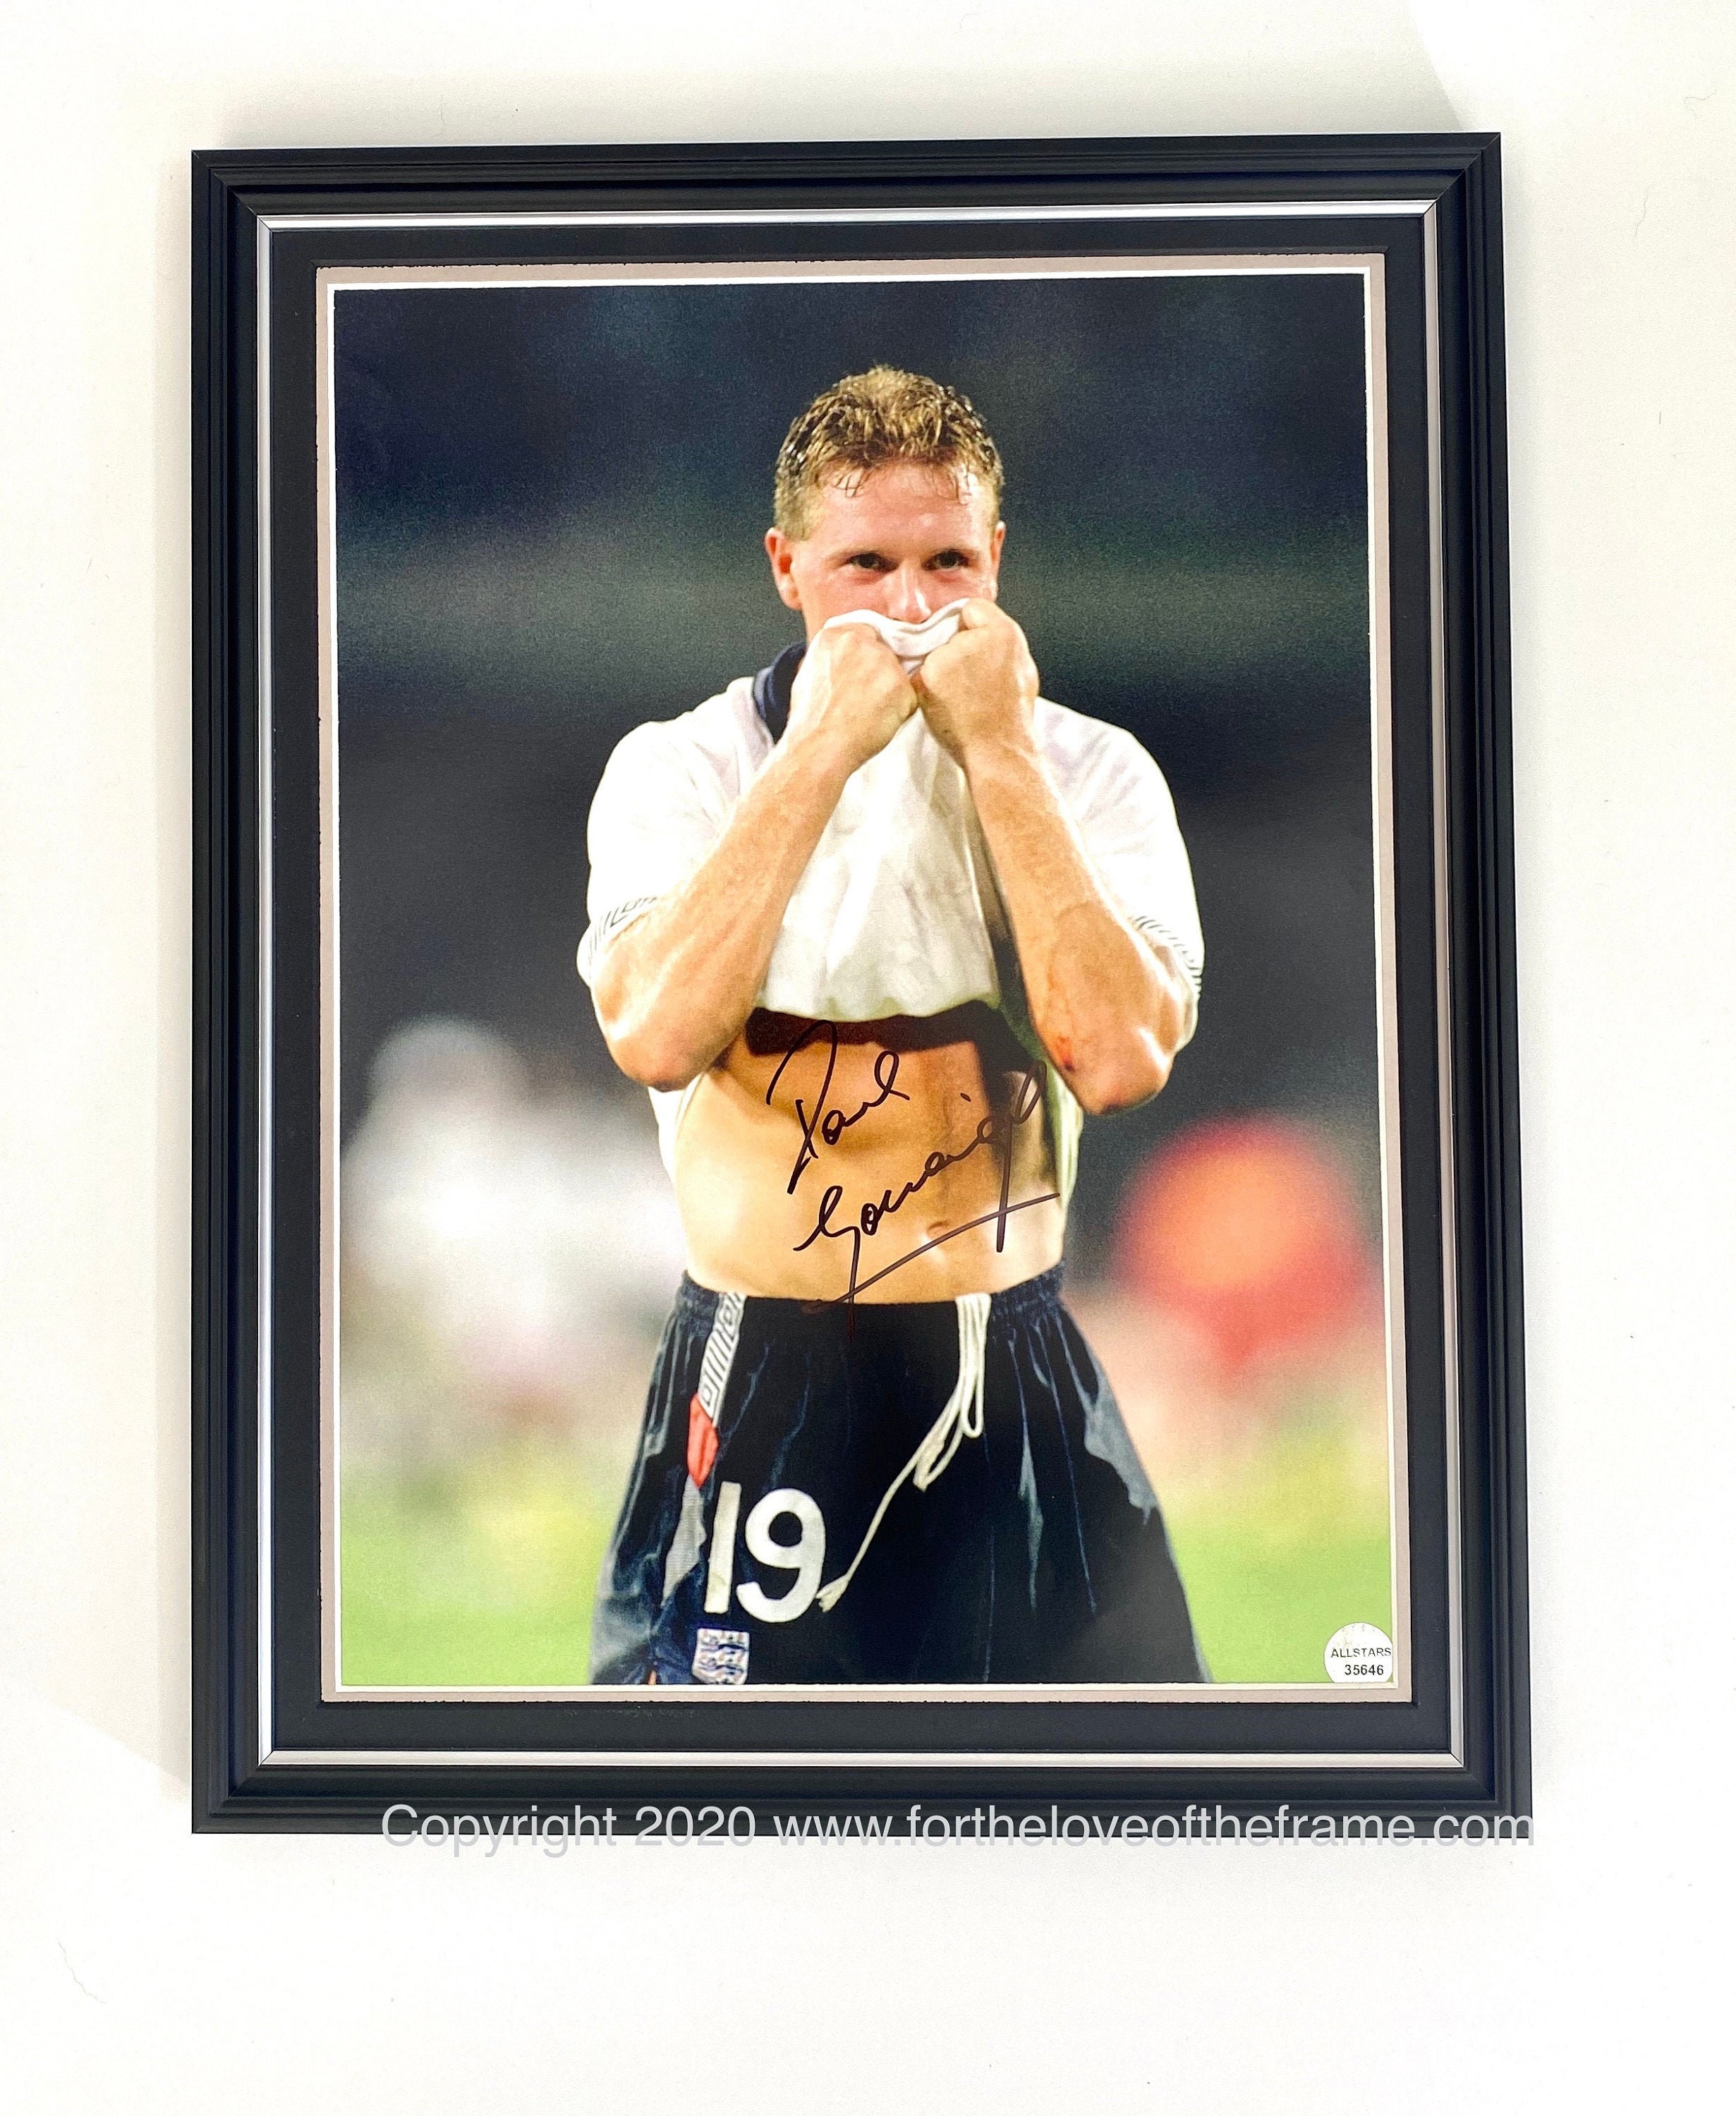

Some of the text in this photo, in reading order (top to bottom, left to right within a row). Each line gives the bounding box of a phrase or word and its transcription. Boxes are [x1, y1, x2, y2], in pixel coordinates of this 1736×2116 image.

[766, 1019, 910, 1194] Paul
[704, 1480, 826, 1622] 19
[1330, 1647, 1392, 1658] ALLSTARS
[1344, 1664, 1384, 1676] 35646
